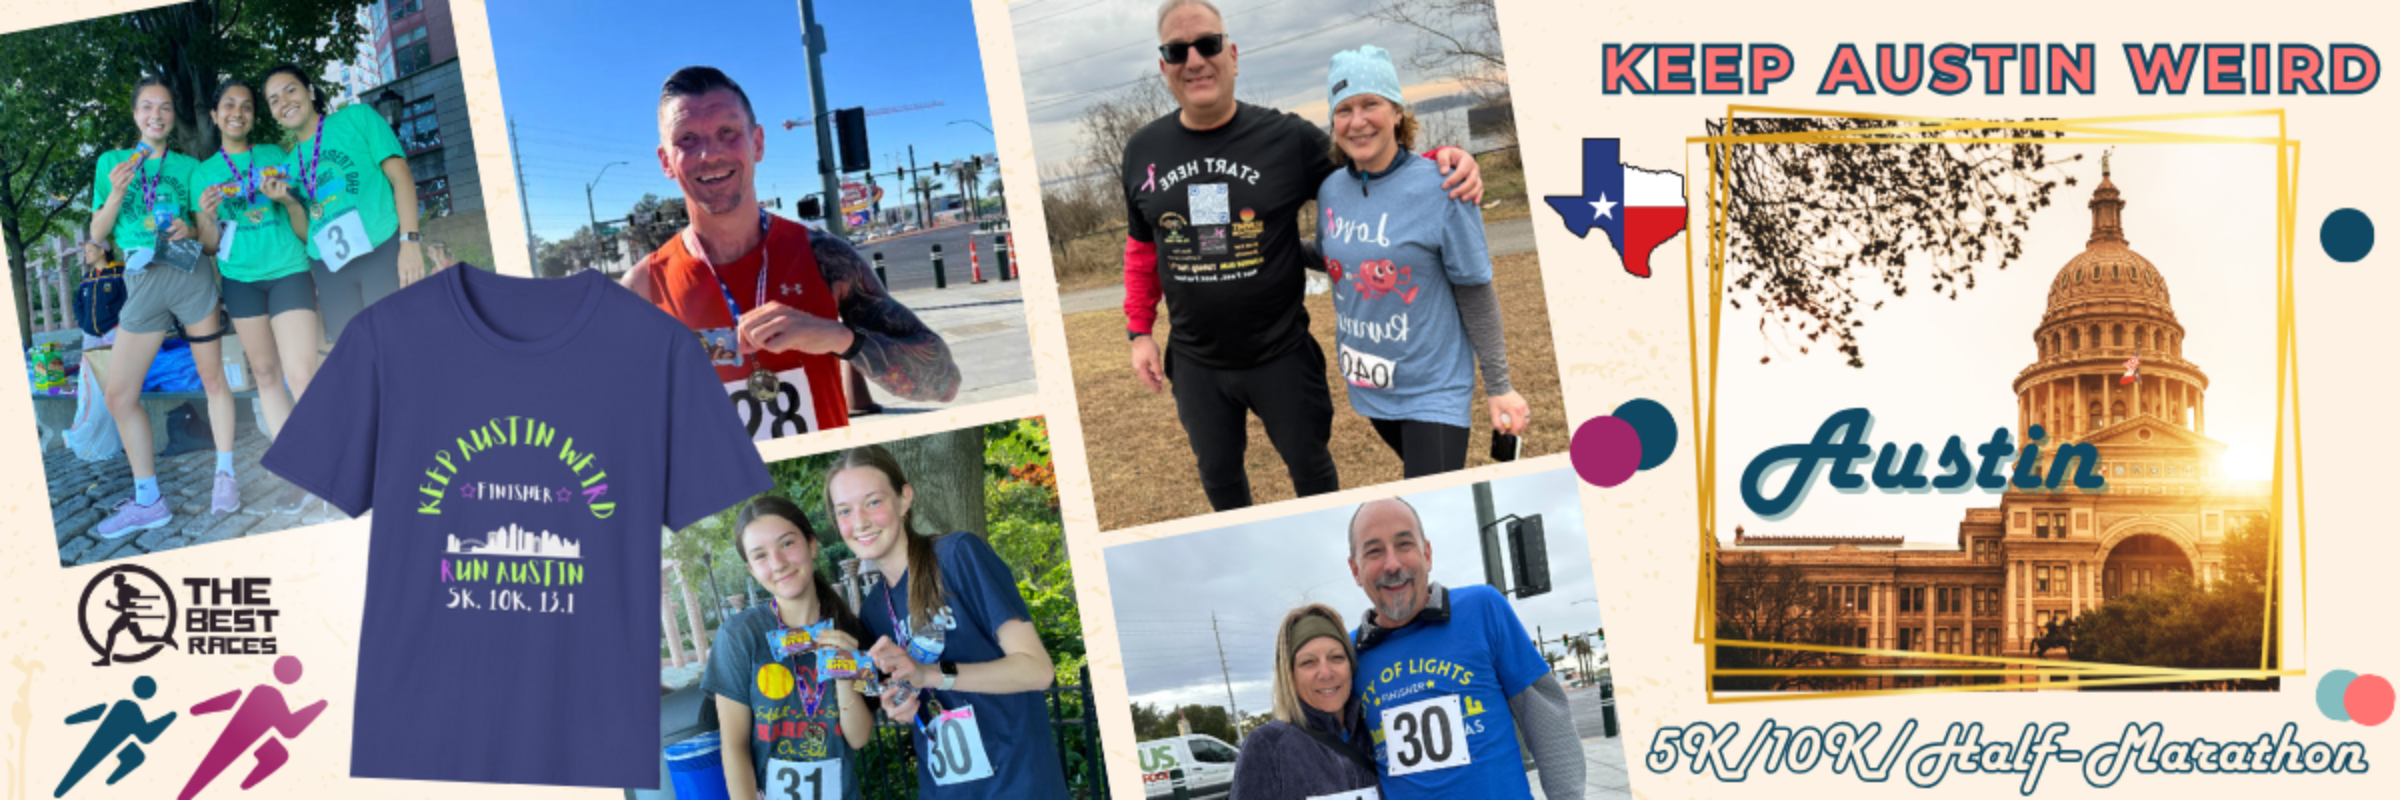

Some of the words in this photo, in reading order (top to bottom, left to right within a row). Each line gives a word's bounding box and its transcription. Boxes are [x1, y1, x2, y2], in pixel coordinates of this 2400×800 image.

[327, 225, 351, 260] 3
[417, 449, 458, 515] KEEP
[456, 415, 556, 462] AUSTIN
[558, 437, 616, 519] WEIRD
[477, 481, 553, 504] FINISHER
[441, 557, 489, 583] RUN
[496, 559, 584, 587] AUSTIN
[539, 591, 575, 614] 13.1
[1380, 661, 1402, 683] OF
[1409, 658, 1474, 685] LIGHTS
[1381, 681, 1425, 702] FINISHER
[931, 718, 972, 780] 30
[1393, 705, 1453, 768] 30
[776, 767, 823, 800] 31
